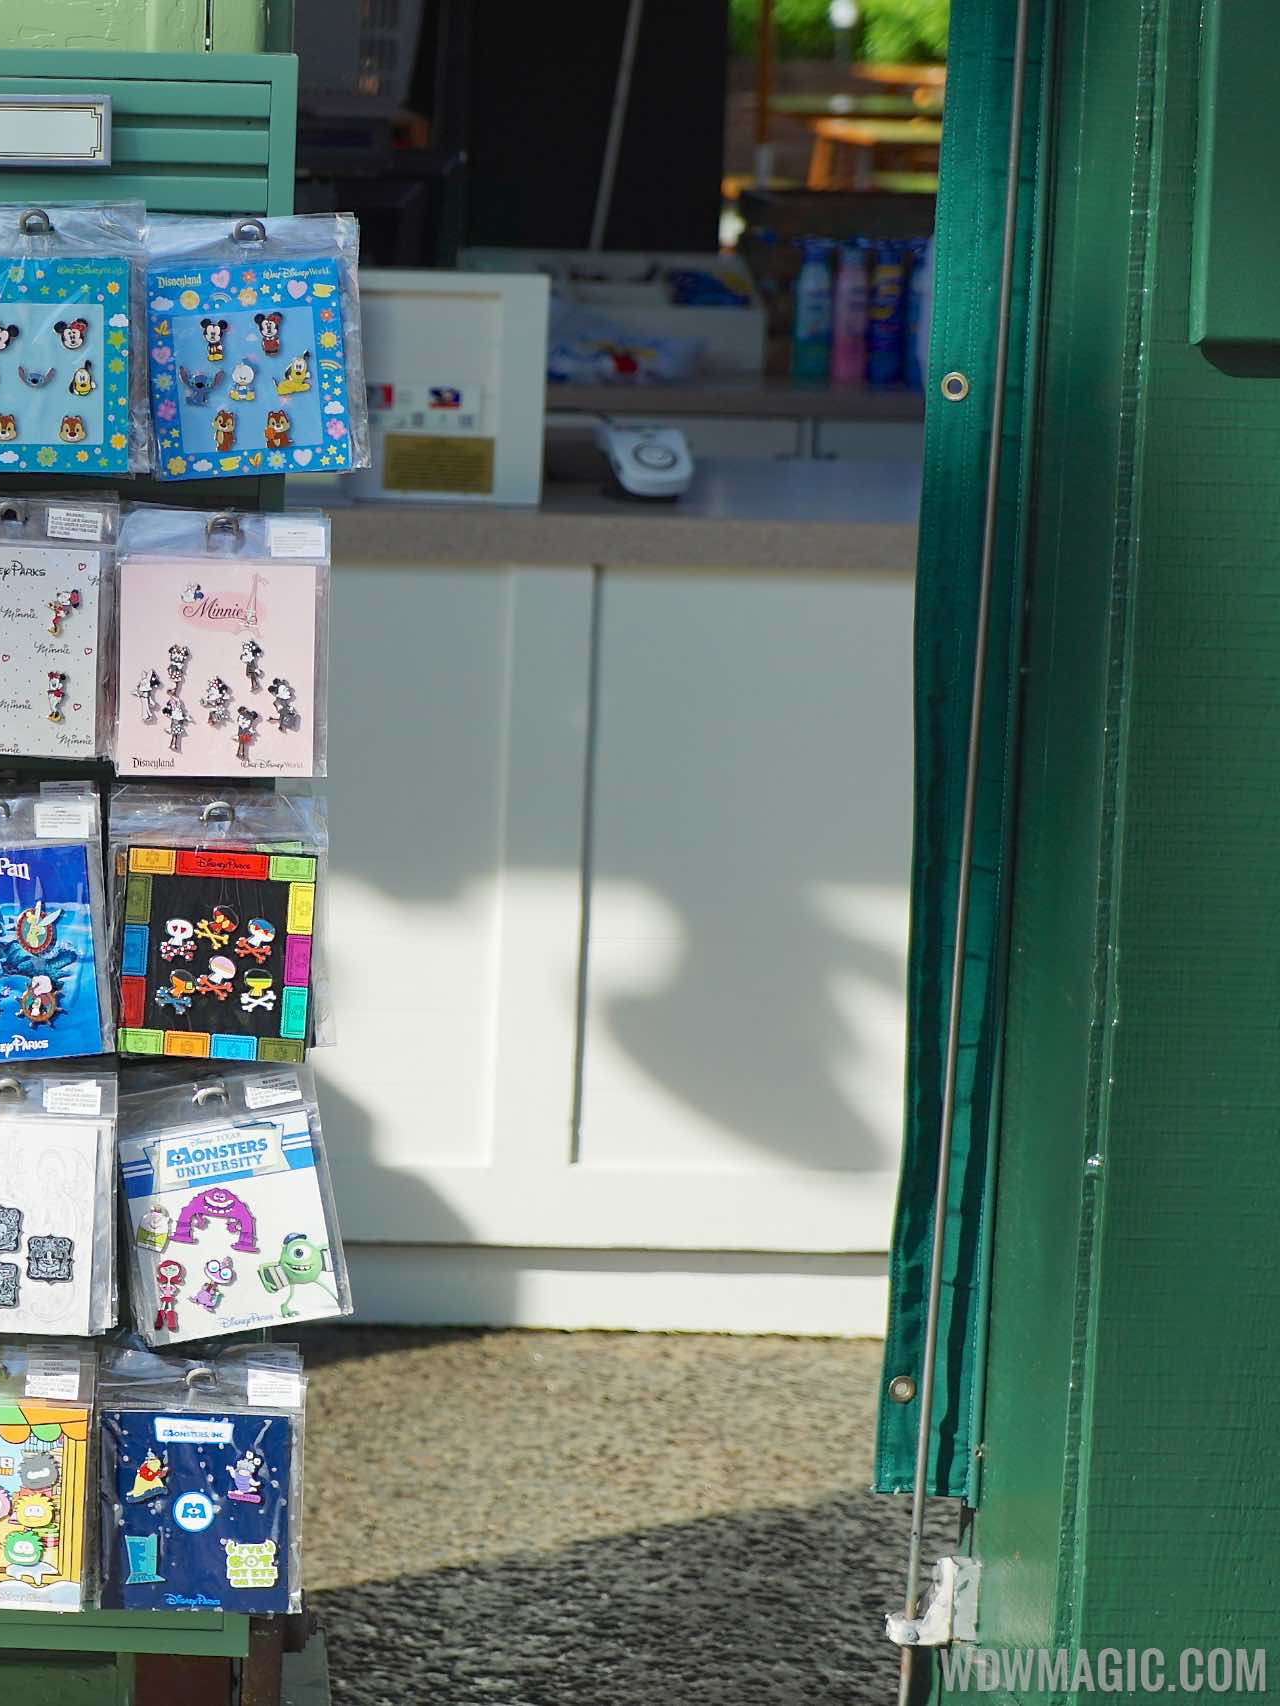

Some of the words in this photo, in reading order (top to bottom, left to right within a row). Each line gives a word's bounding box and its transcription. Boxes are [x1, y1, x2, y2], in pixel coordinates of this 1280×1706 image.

[156, 274, 202, 288] Disneyland
[0, 606, 38, 620] Minnie
[183, 597, 246, 620] Minnie
[34, 642, 71, 655] Minnie
[132, 757, 174, 769] Disneyland
[167, 1138, 268, 1167] MONSTERS
[176, 1154, 263, 1178] UNIVERSITY
